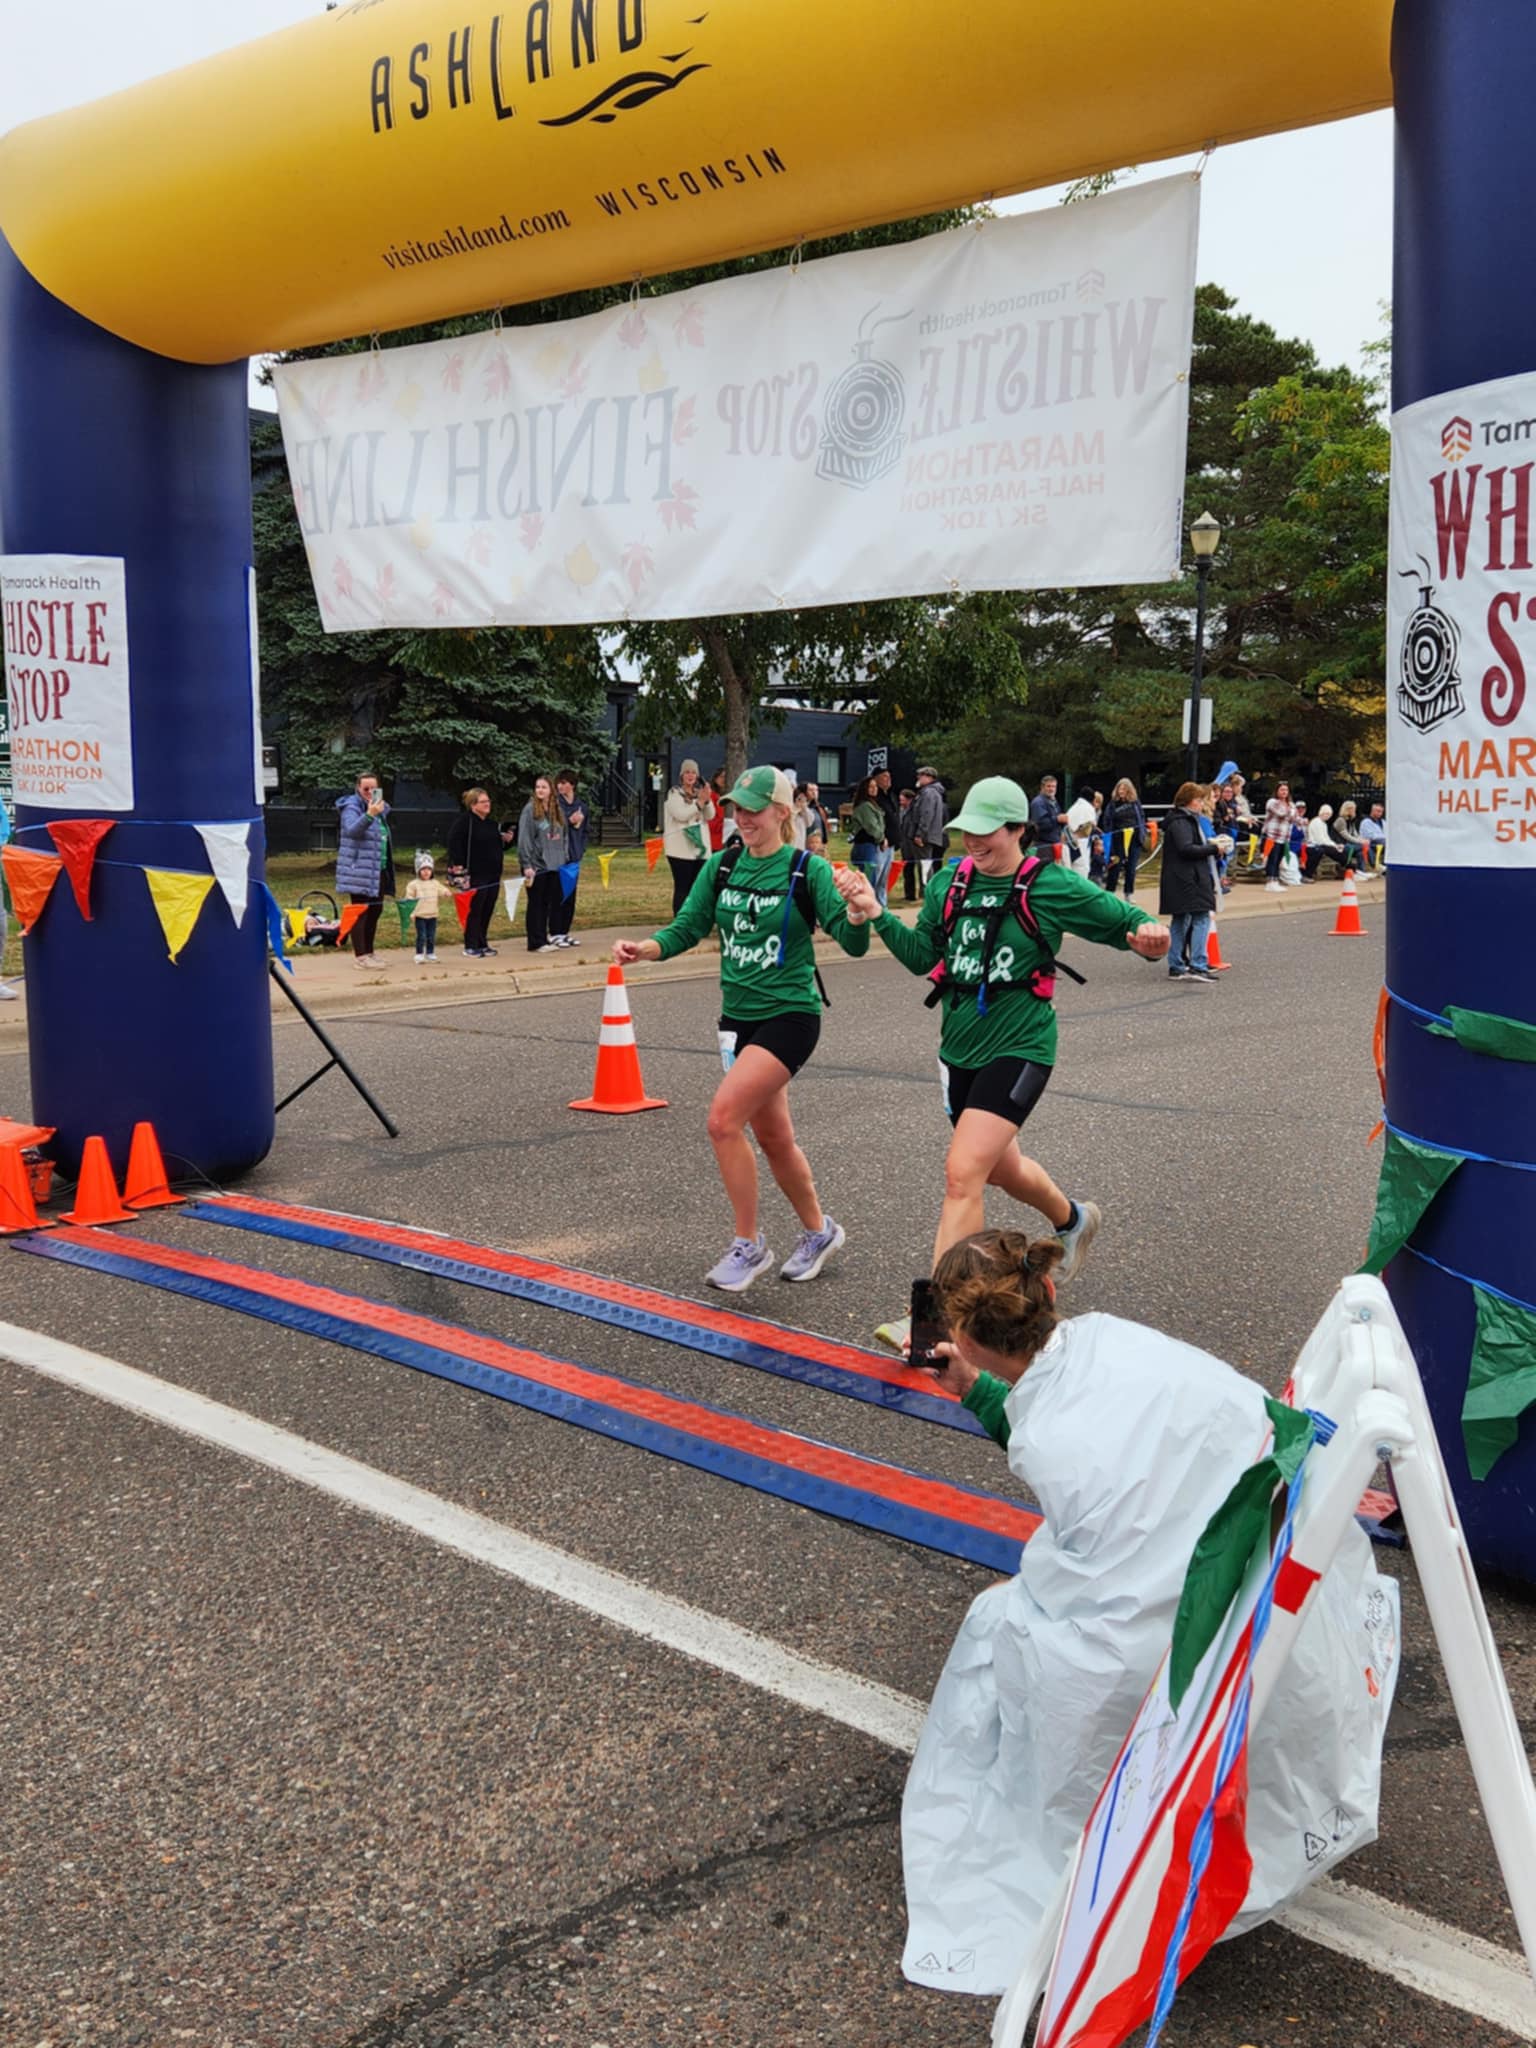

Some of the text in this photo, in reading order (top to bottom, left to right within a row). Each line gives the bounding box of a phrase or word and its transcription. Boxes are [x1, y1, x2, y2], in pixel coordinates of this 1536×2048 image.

[370, 0, 648, 134] ASHLAND
[595, 147, 787, 218] WISCONSIN
[382, 207, 572, 271] visitashland.com
[49, 575, 101, 591] Health
[5, 599, 110, 667] HISTLE
[1481, 591, 1536, 727] S
[962, 919, 986, 945] for
